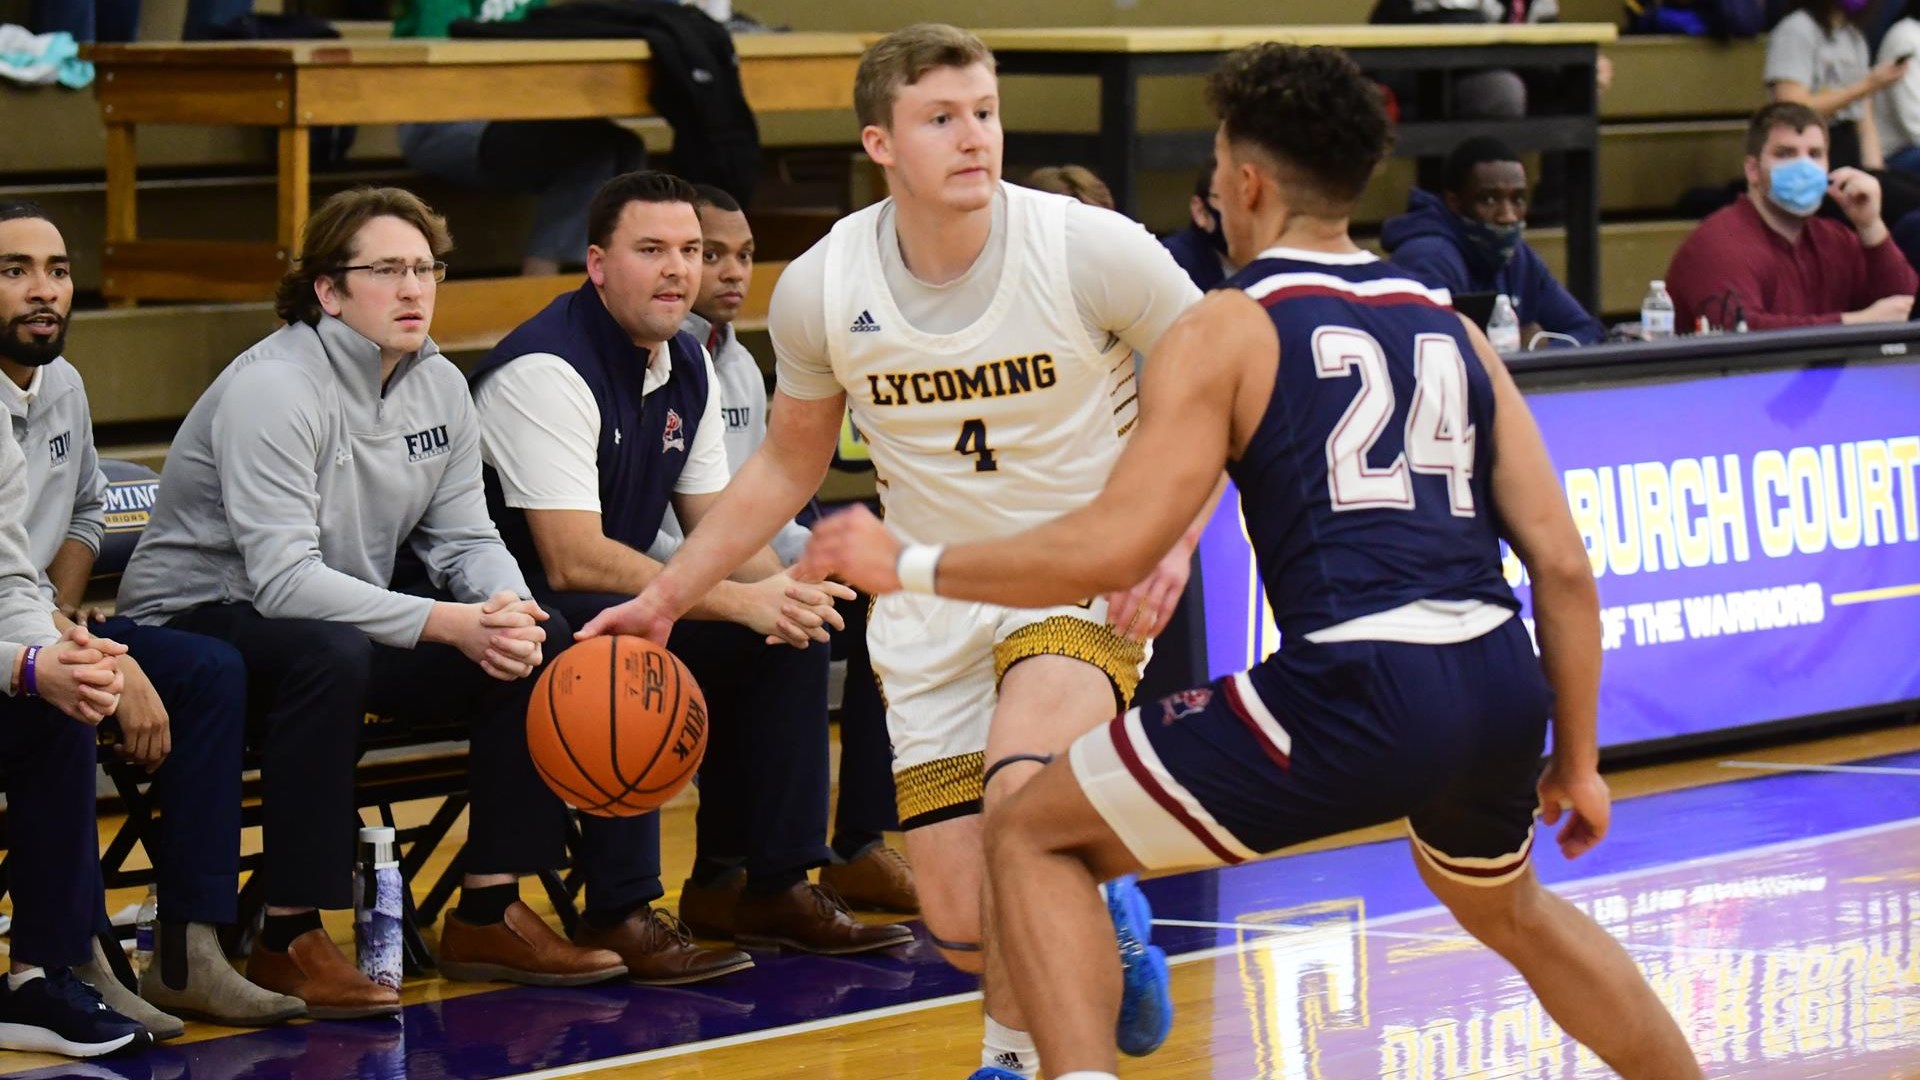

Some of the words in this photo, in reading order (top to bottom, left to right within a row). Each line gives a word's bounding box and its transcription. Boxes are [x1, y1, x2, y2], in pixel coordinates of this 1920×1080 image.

[850, 324, 881, 333] adidas
[866, 353, 1056, 406] LYCOMING
[404, 424, 449, 456] FDU
[954, 418, 998, 472] 4
[1310, 324, 1476, 518] 24
[1565, 453, 1750, 578] BURCH
[1752, 436, 1920, 560] COURT
[1627, 599, 1686, 647] THE
[1683, 582, 1825, 639] WARRIORS
